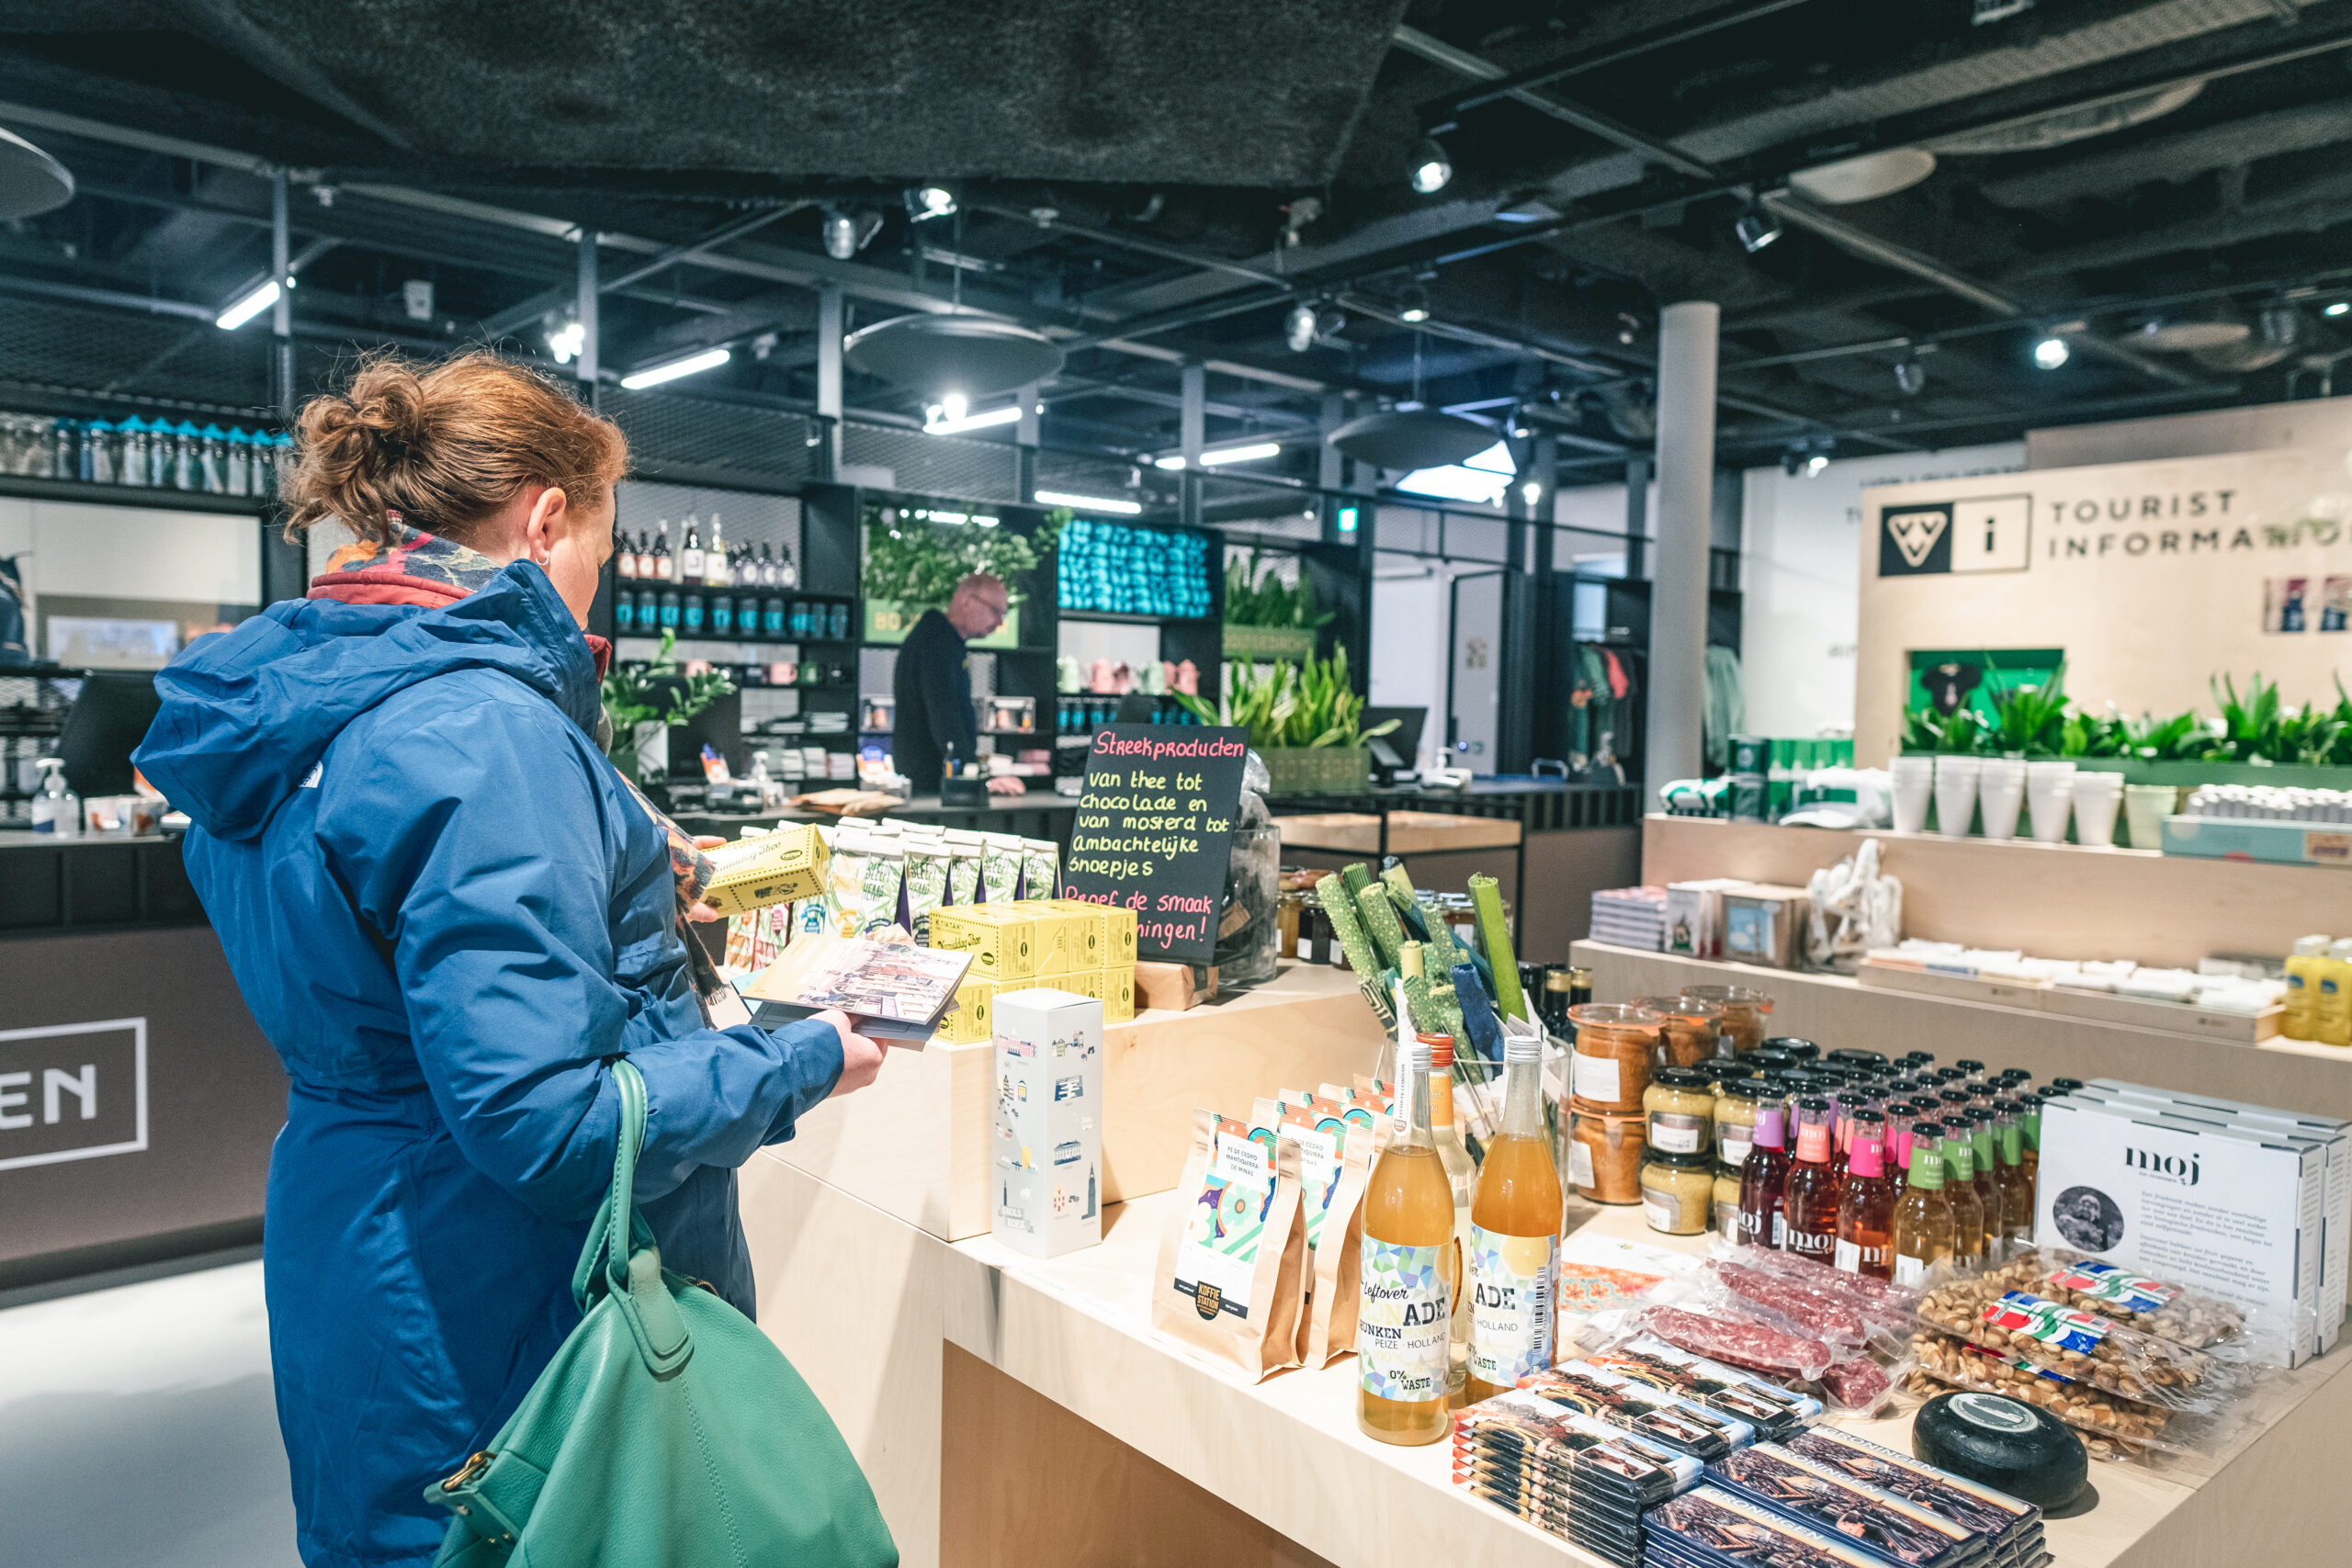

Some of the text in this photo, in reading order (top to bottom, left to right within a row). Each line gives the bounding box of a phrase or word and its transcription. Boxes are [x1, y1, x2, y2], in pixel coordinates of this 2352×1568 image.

[2051, 489, 2237, 525] TOURIST
[2050, 517, 2352, 558] INFORMAIO
[1093, 730, 1245, 761] Streekproducten
[1090, 770, 1203, 791] van thee tot
[1189, 797, 1208, 812] en
[1079, 815, 1230, 833] van mosterd tot
[1125, 890, 1148, 911] de
[1157, 894, 1213, 915] smaak
[0, 1064, 96, 1130] EN
[2124, 1145, 2200, 1187] moj
[1197, 1294, 1219, 1310] STATION
[1198, 1283, 1221, 1300] KOFFIE
[1476, 1282, 1516, 1310] ADE
[1476, 1319, 1519, 1332] HOLLAND
[1374, 1332, 1446, 1349] PEIZE HOLLAND
[1389, 1370, 1407, 1380] 0%
[1401, 1377, 1430, 1391] WASTE
[1824, 1427, 1938, 1472] GRONINGEN
[1767, 1443, 1880, 1494] GRONINGEN
[1706, 1489, 1824, 1540] GRONINGEN
